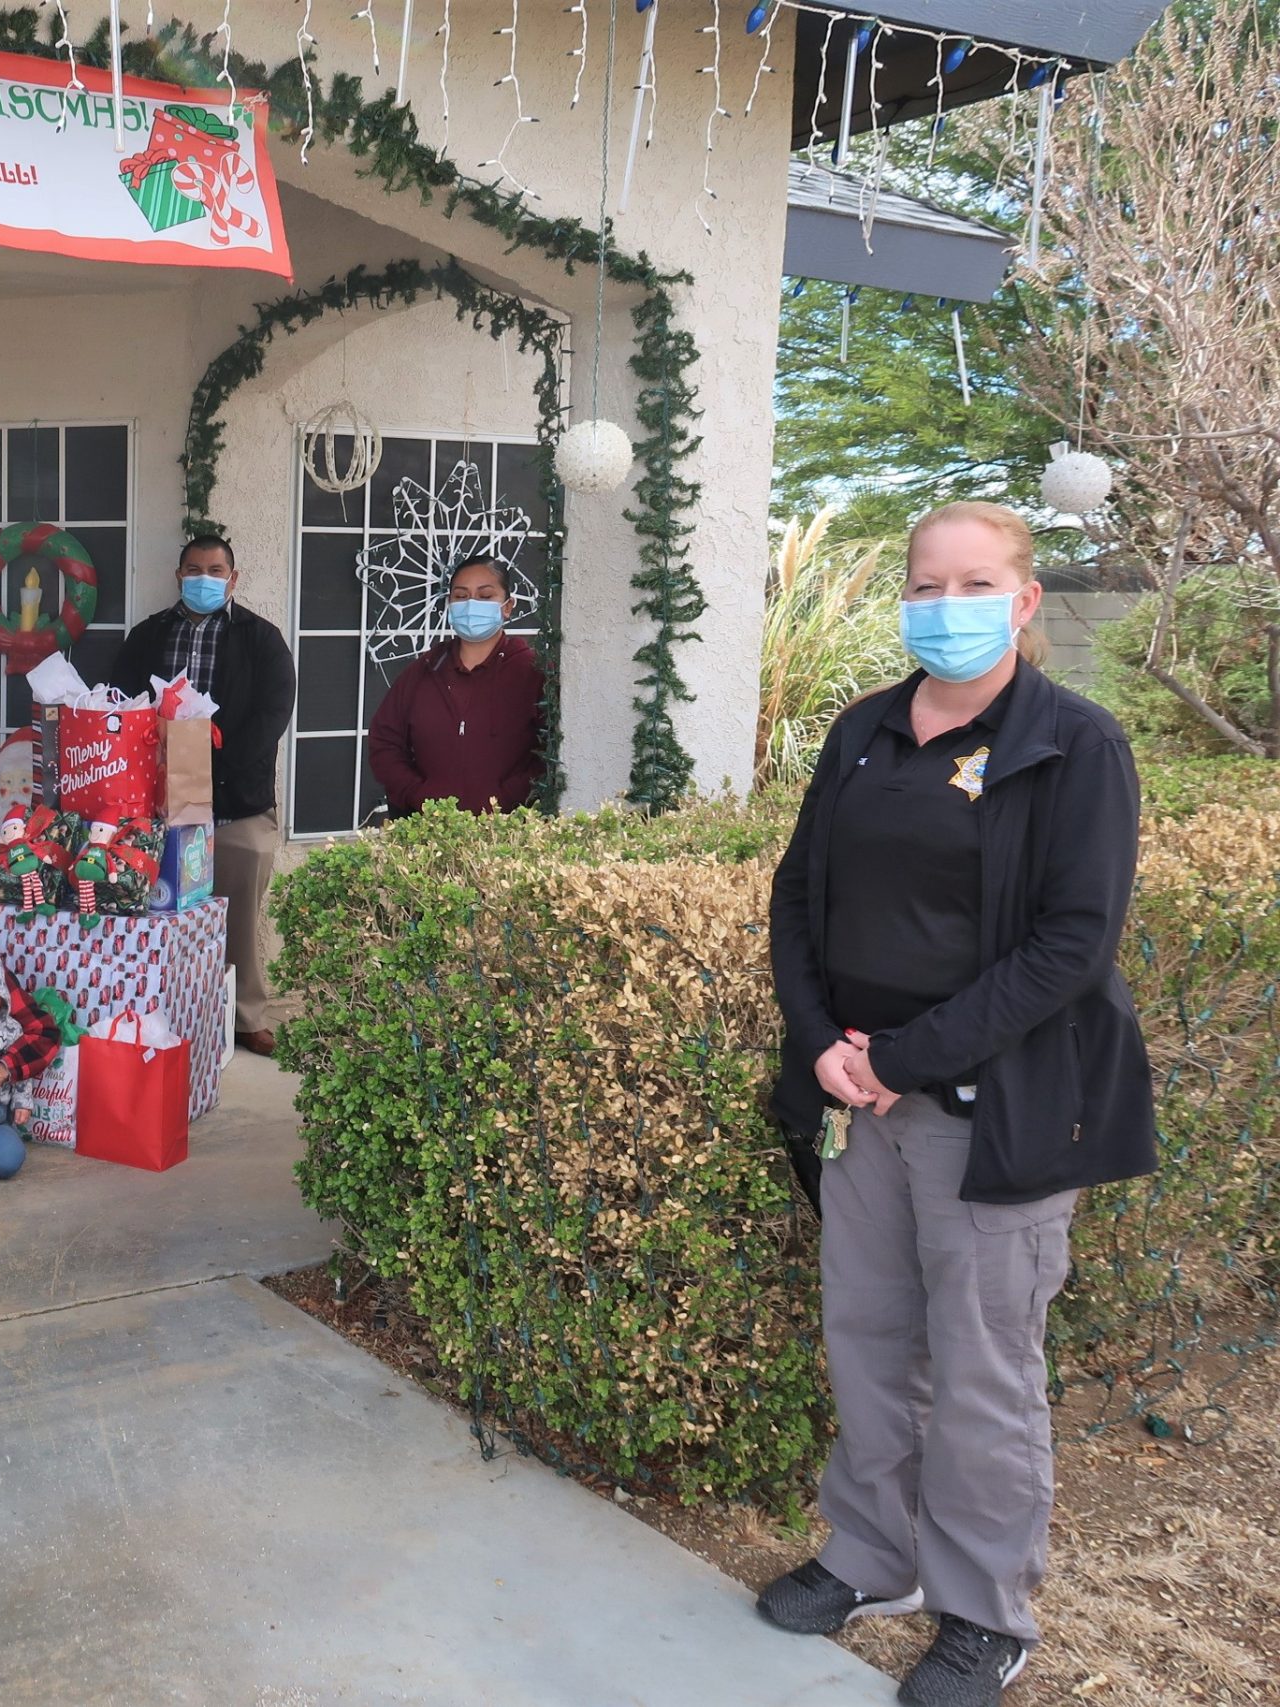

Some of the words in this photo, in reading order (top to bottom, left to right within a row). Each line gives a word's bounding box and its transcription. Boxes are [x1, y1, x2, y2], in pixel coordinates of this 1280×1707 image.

[65, 738, 112, 769] Merry
[58, 756, 128, 795] Christmas
[32, 1079, 73, 1106] derful
